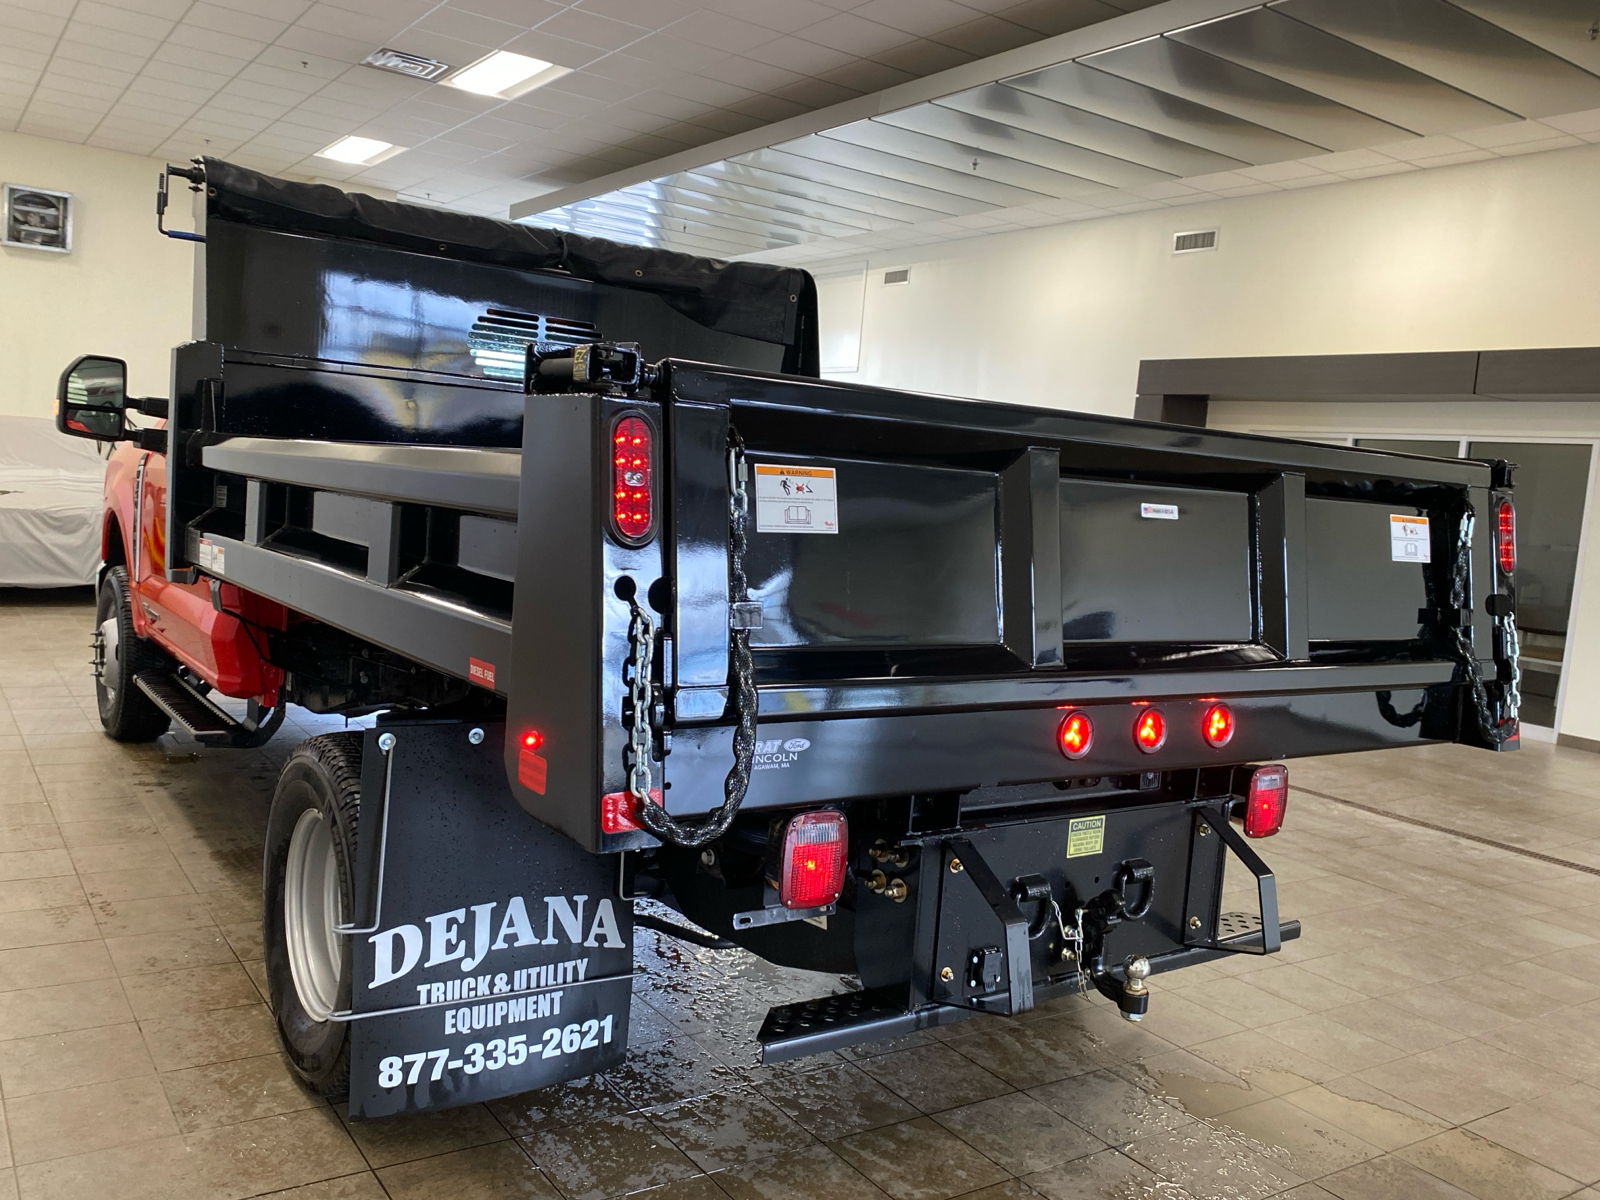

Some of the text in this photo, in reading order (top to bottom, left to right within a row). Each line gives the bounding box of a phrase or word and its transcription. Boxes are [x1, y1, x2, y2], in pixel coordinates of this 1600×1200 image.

[786, 469, 812, 477] WARNING
[470, 664, 494, 682] DIESEL FUEL
[754, 739, 782, 754] RAT
[752, 753, 797, 764] INCOLN
[1073, 820, 1101, 830] CAUTION
[368, 894, 626, 989] DEJANA
[417, 958, 588, 1005] TRUCK & UTILITY
[444, 991, 563, 1035] EQUIPMENT
[378, 1014, 613, 1089] 877-335-2621
